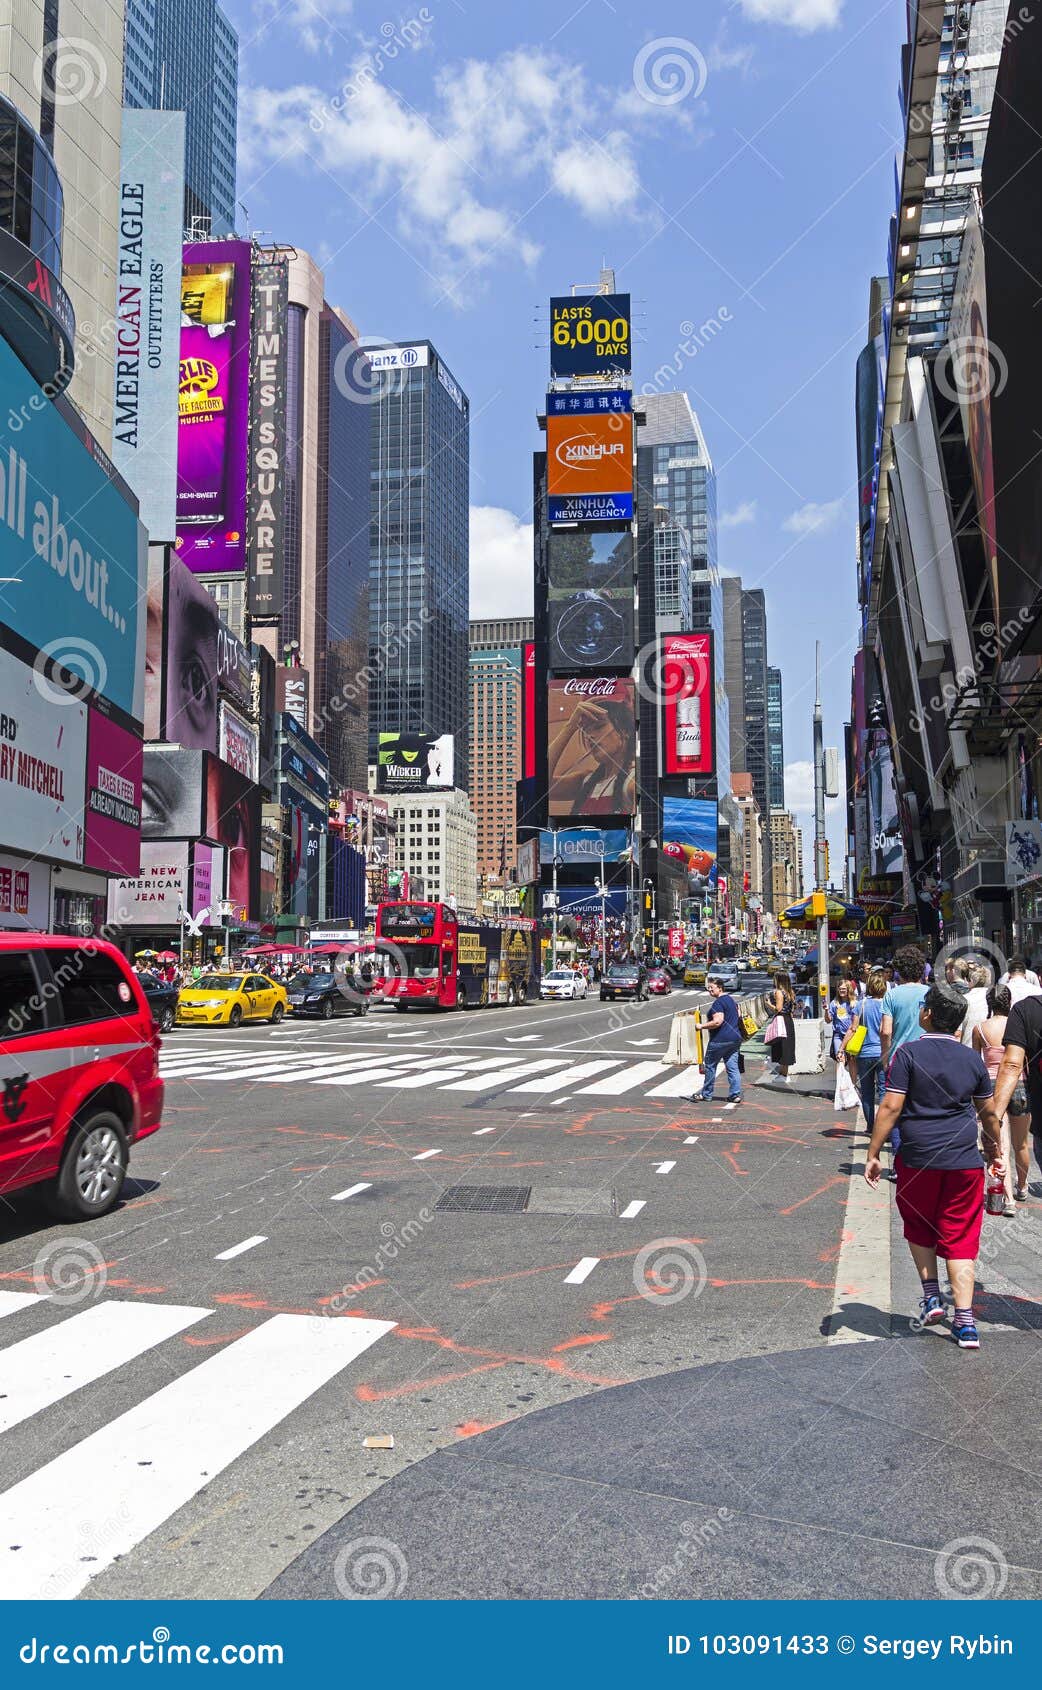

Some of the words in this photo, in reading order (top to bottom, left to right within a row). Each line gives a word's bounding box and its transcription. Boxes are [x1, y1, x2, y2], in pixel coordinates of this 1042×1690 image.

[119, 183, 144, 278] EAGLE
[149, 264, 164, 369] OUTFITTERS
[554, 307, 592, 320] LASTS
[553, 318, 628, 349] 6,000
[257, 284, 280, 407] TIMES
[596, 343, 628, 356] DAYS
[116, 285, 142, 448] AMERICAN
[191, 399, 222, 411] FACTORY
[555, 397, 623, 410] 新华通讯社
[566, 443, 624, 456] XINHUA
[255, 422, 279, 575] SQUARE
[566, 498, 615, 510] XINHUA
[555, 510, 583, 518] NEWS
[586, 508, 626, 518] AGENCY
[255, 593, 273, 601] NYC
[216, 628, 238, 677] CATS
[564, 678, 617, 696] Coca-Cola
[17, 750, 64, 803] MITCHELL
[99, 769, 116, 795] TAXES
[121, 779, 134, 801] FEES
[90, 790, 114, 817] ALREADY
[114, 801, 140, 827] INCLUDED
[119, 880, 181, 889] AMERICAN
[134, 893, 165, 901] JEAN
